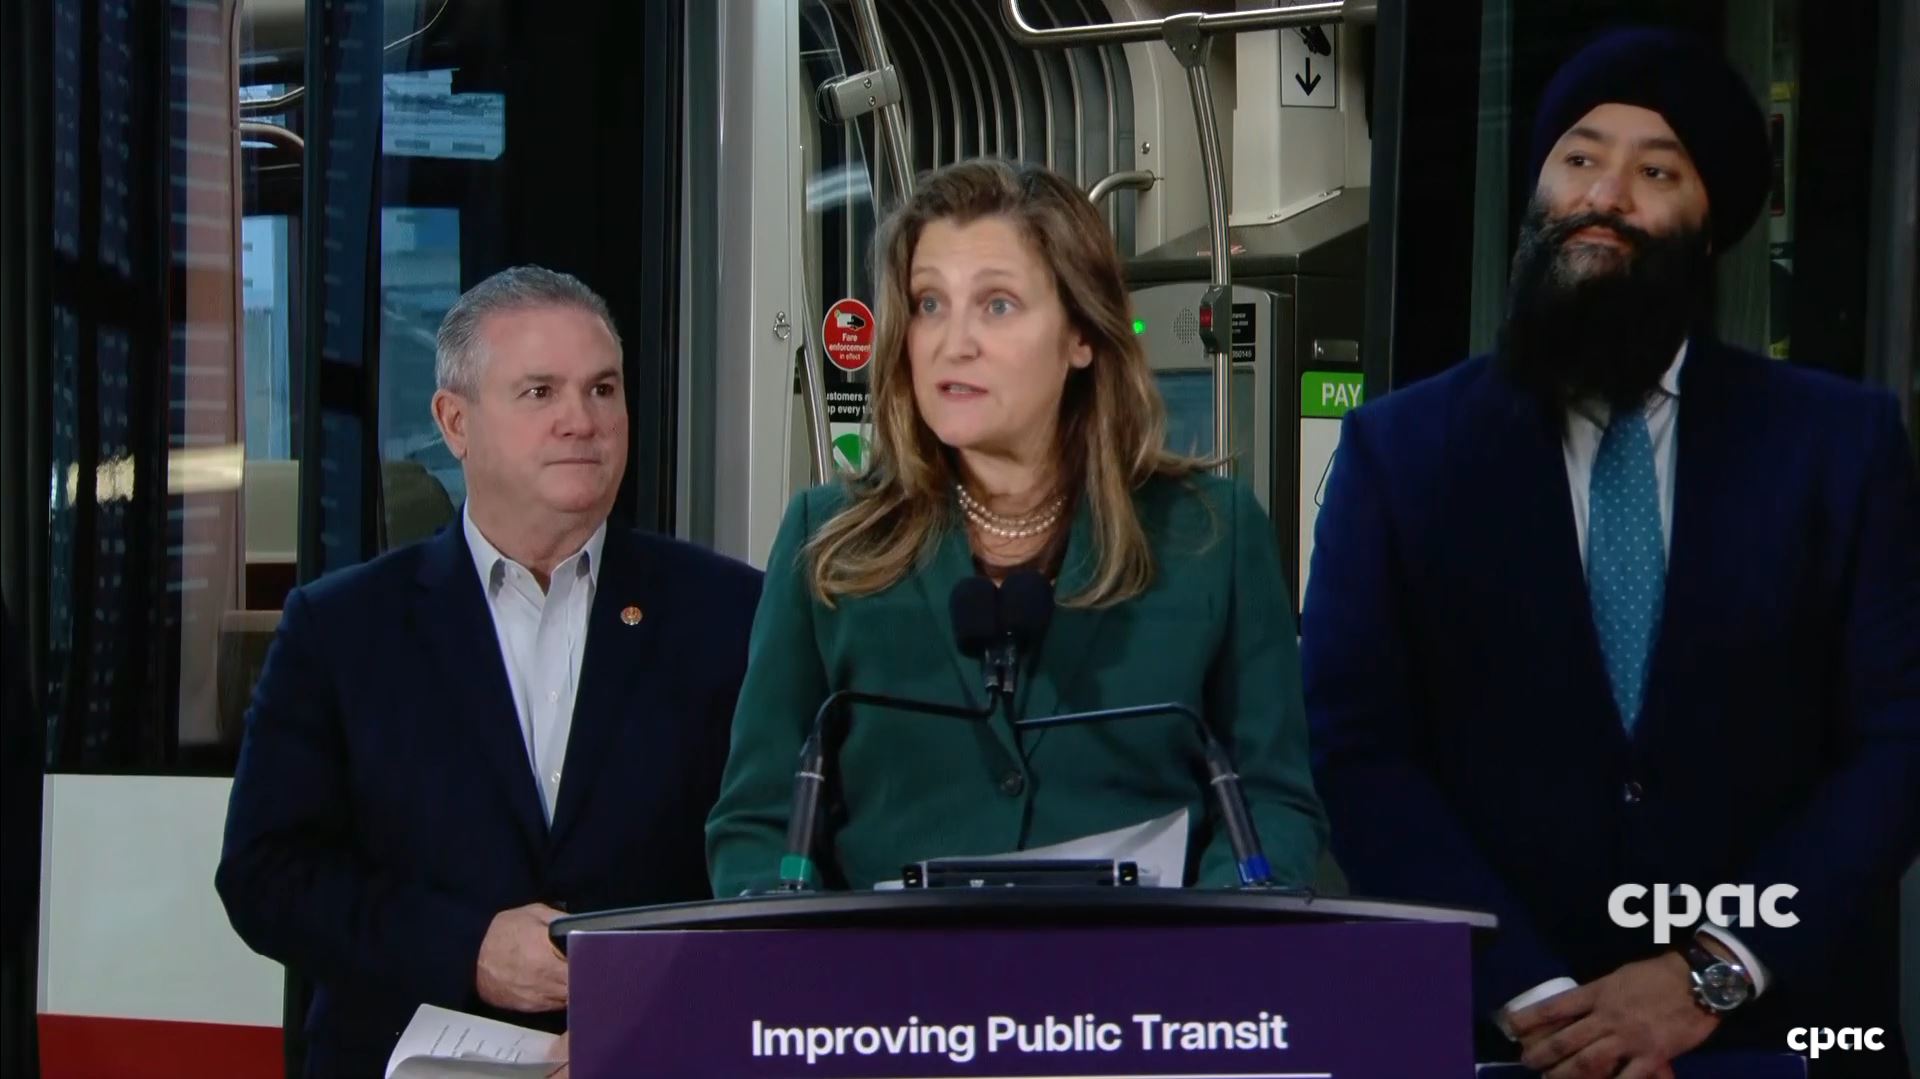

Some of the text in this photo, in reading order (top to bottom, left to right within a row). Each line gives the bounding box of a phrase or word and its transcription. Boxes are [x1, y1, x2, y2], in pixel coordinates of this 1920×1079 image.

[842, 333, 858, 342] Fare
[828, 343, 872, 352] enforcement
[846, 353, 861, 361] effect
[1321, 383, 1361, 408] PAY
[837, 405, 861, 417] every
[752, 1011, 1289, 1064] Improving Public Transit
